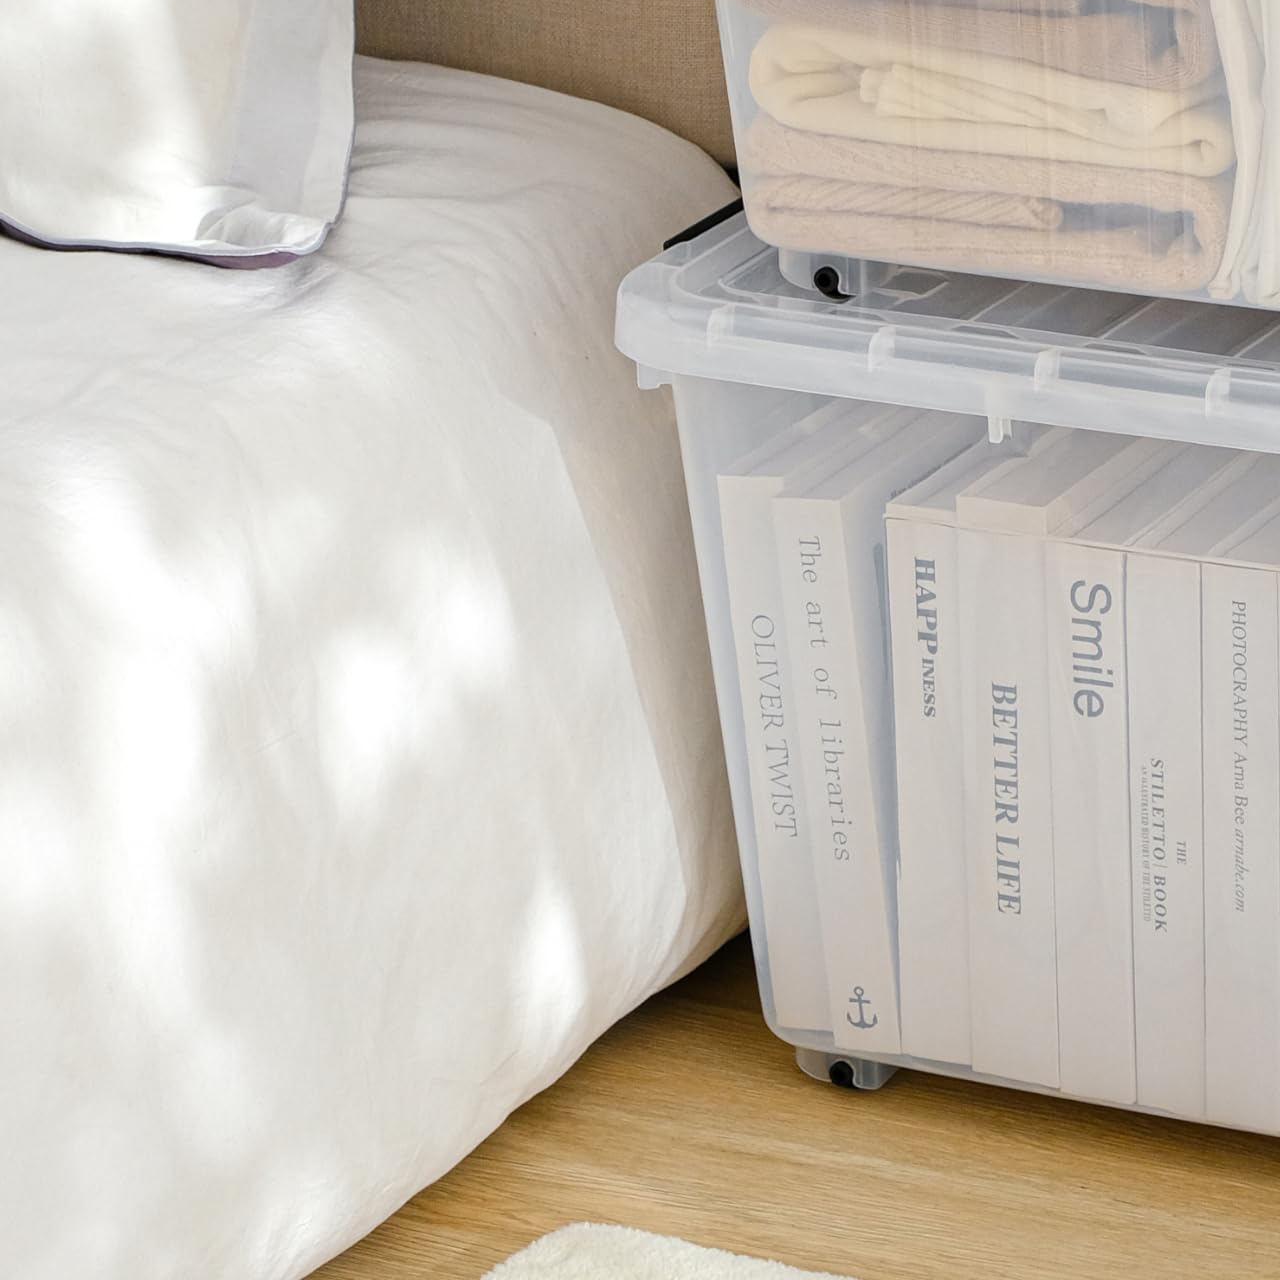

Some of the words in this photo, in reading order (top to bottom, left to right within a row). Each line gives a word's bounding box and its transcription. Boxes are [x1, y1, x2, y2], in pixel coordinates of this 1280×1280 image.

[798, 536, 819, 584] The
[807, 601, 828, 648] art
[1070, 579, 1114, 717] Smile
[751, 614, 785, 731] OLIVER
[815, 668, 838, 700] of
[991, 682, 1020, 824] BETTER
[1233, 751, 1247, 790] Arna
[765, 739, 798, 837] TWIST
[819, 717, 852, 861] libraries
[1233, 795, 1248, 824] Bee
[995, 833, 1021, 915] LIFE
[1176, 840, 1187, 865] THE
[1153, 875, 1167, 933] BOOK
